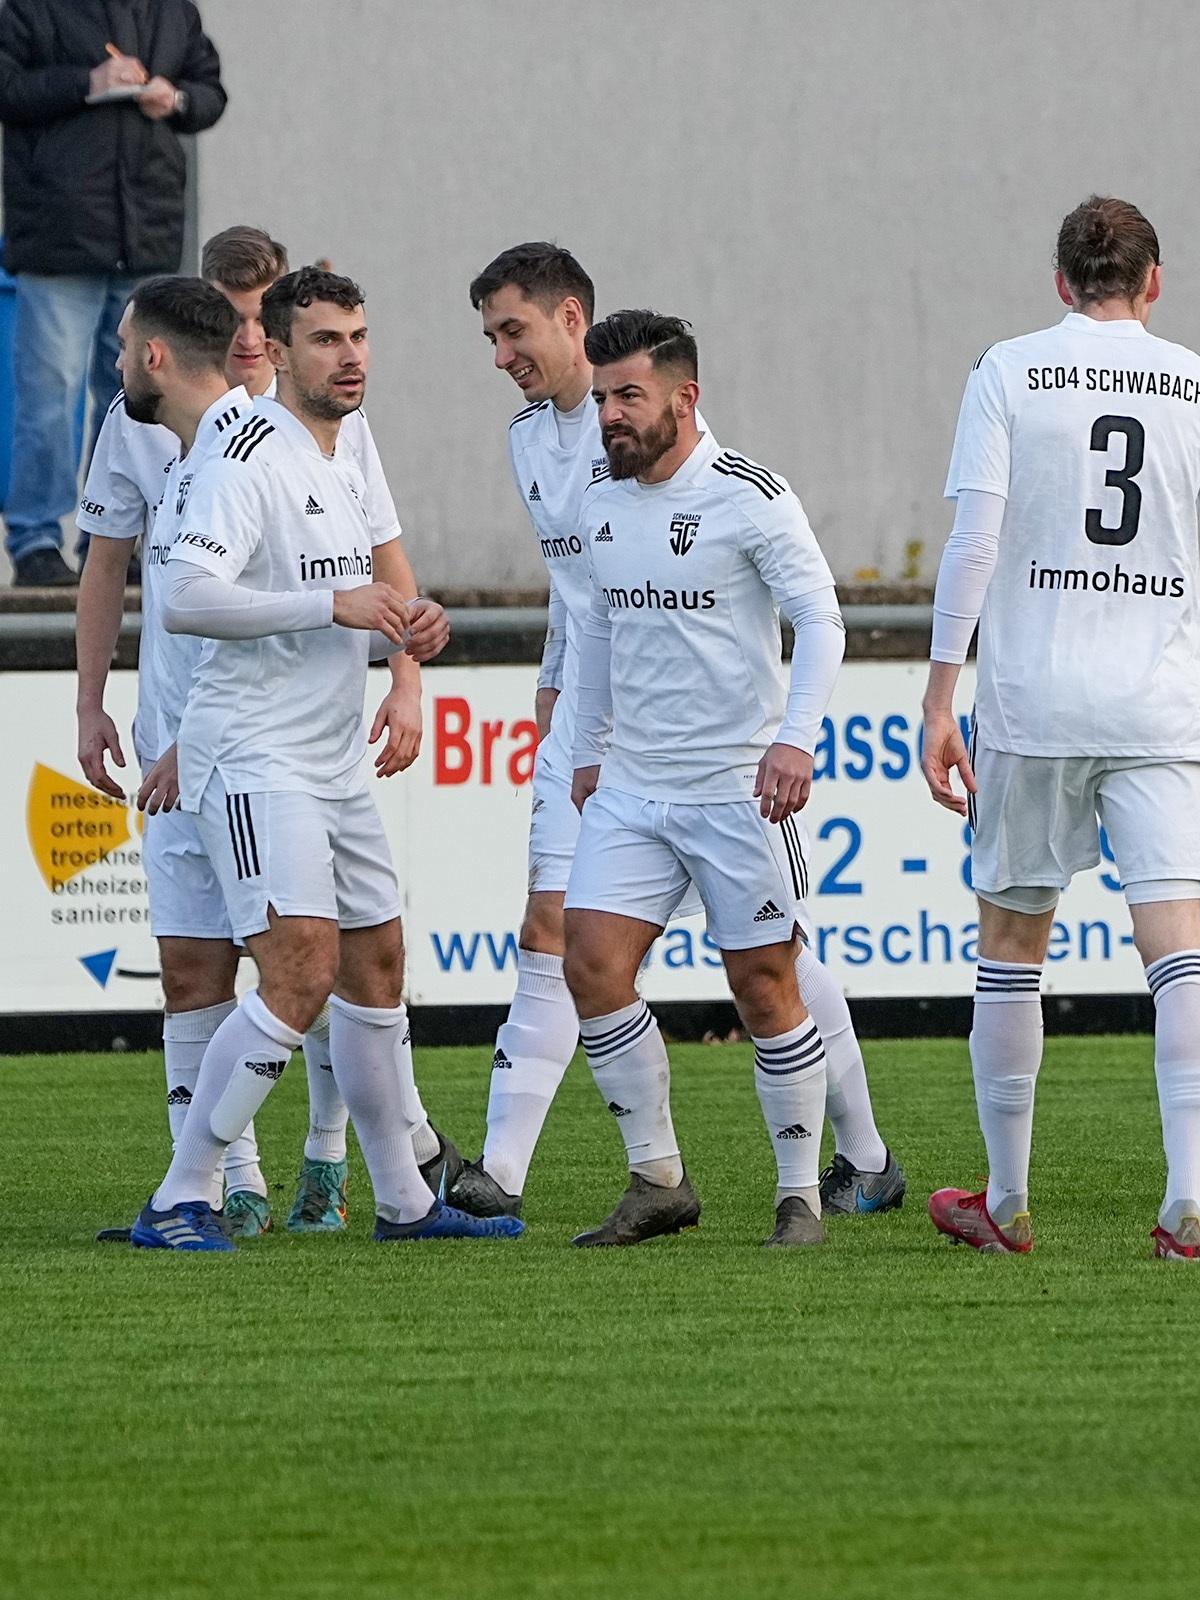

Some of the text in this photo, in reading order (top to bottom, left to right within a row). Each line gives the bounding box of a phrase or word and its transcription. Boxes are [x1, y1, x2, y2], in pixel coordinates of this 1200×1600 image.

[1028, 366, 1080, 390] SC04
[1085, 414, 1146, 546] 3
[80, 500, 106, 517] SER
[181, 532, 227, 557] FESER
[594, 533, 613, 542] adidas
[1029, 559, 1185, 598] immohaus
[50, 818, 114, 838] orten
[50, 847, 142, 867] trockne
[753, 911, 786, 923] adidas
[776, 1130, 812, 1140] adidas
